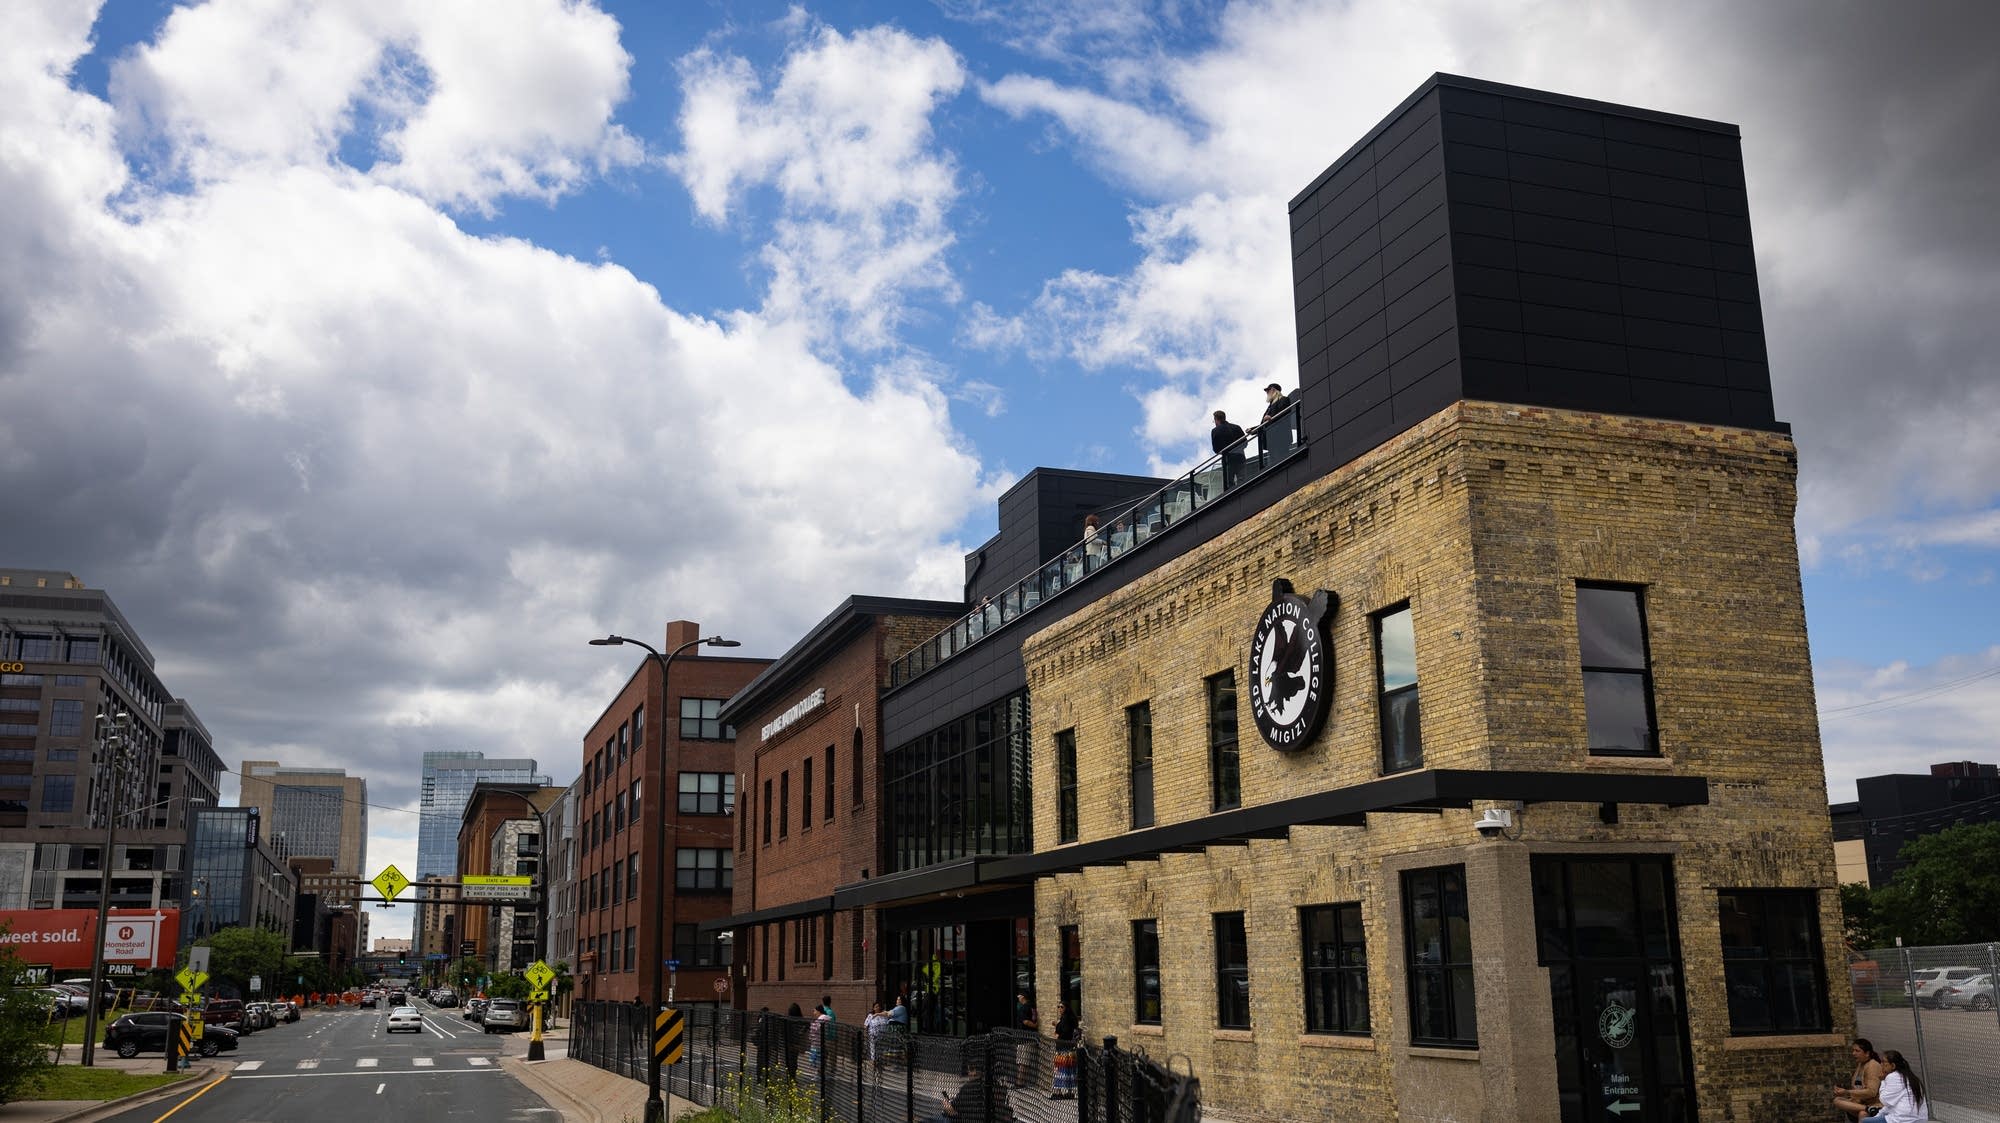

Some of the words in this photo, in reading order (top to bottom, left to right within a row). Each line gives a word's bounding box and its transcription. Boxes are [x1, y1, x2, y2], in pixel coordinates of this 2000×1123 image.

[1264, 602, 1301, 629] NATION
[1252, 631, 1265, 675] LAKE
[1302, 617, 1319, 702] COLLEGE
[0, 662, 24, 673] GO
[1252, 685, 1264, 718] RED
[1269, 717, 1306, 743] MIGIZI
[42, 928, 81, 943] sold.
[105, 940, 146, 948] Homestead
[108, 964, 134, 975] PARK
[1610, 1073, 1630, 1083] Main
[1604, 1086, 1639, 1095] Entrance
